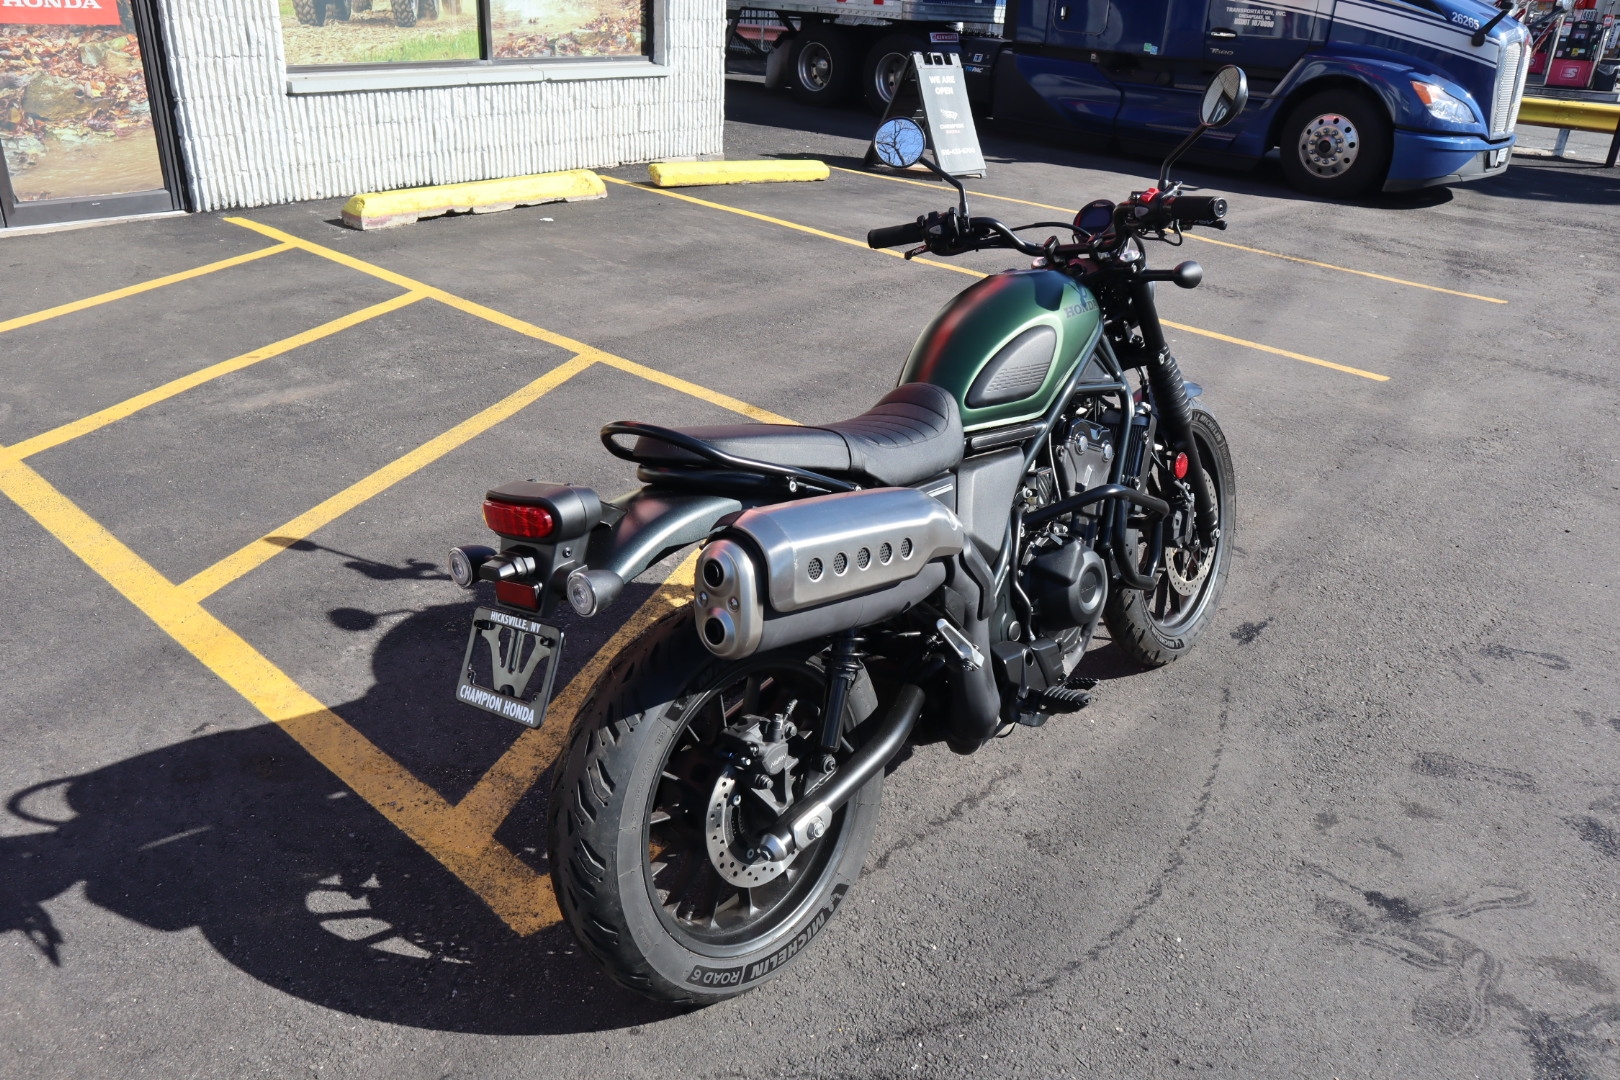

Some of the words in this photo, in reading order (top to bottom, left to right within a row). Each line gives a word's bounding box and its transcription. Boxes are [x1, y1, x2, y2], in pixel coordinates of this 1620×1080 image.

[1452, 11, 1480, 30] 26265
[929, 75, 941, 84] WE
[942, 75, 956, 84] ARE
[935, 86, 954, 95] OPEN
[1063, 299, 1099, 318] HONDA
[490, 611, 528, 631] HICKSVILLE,
[530, 622, 541, 633] NY
[459, 684, 502, 712] CHAMPION
[503, 700, 535, 724] HONDA
[751, 911, 826, 979] MICHELIN
[690, 969, 701, 981] 6
[703, 970, 742, 985] ROAD
